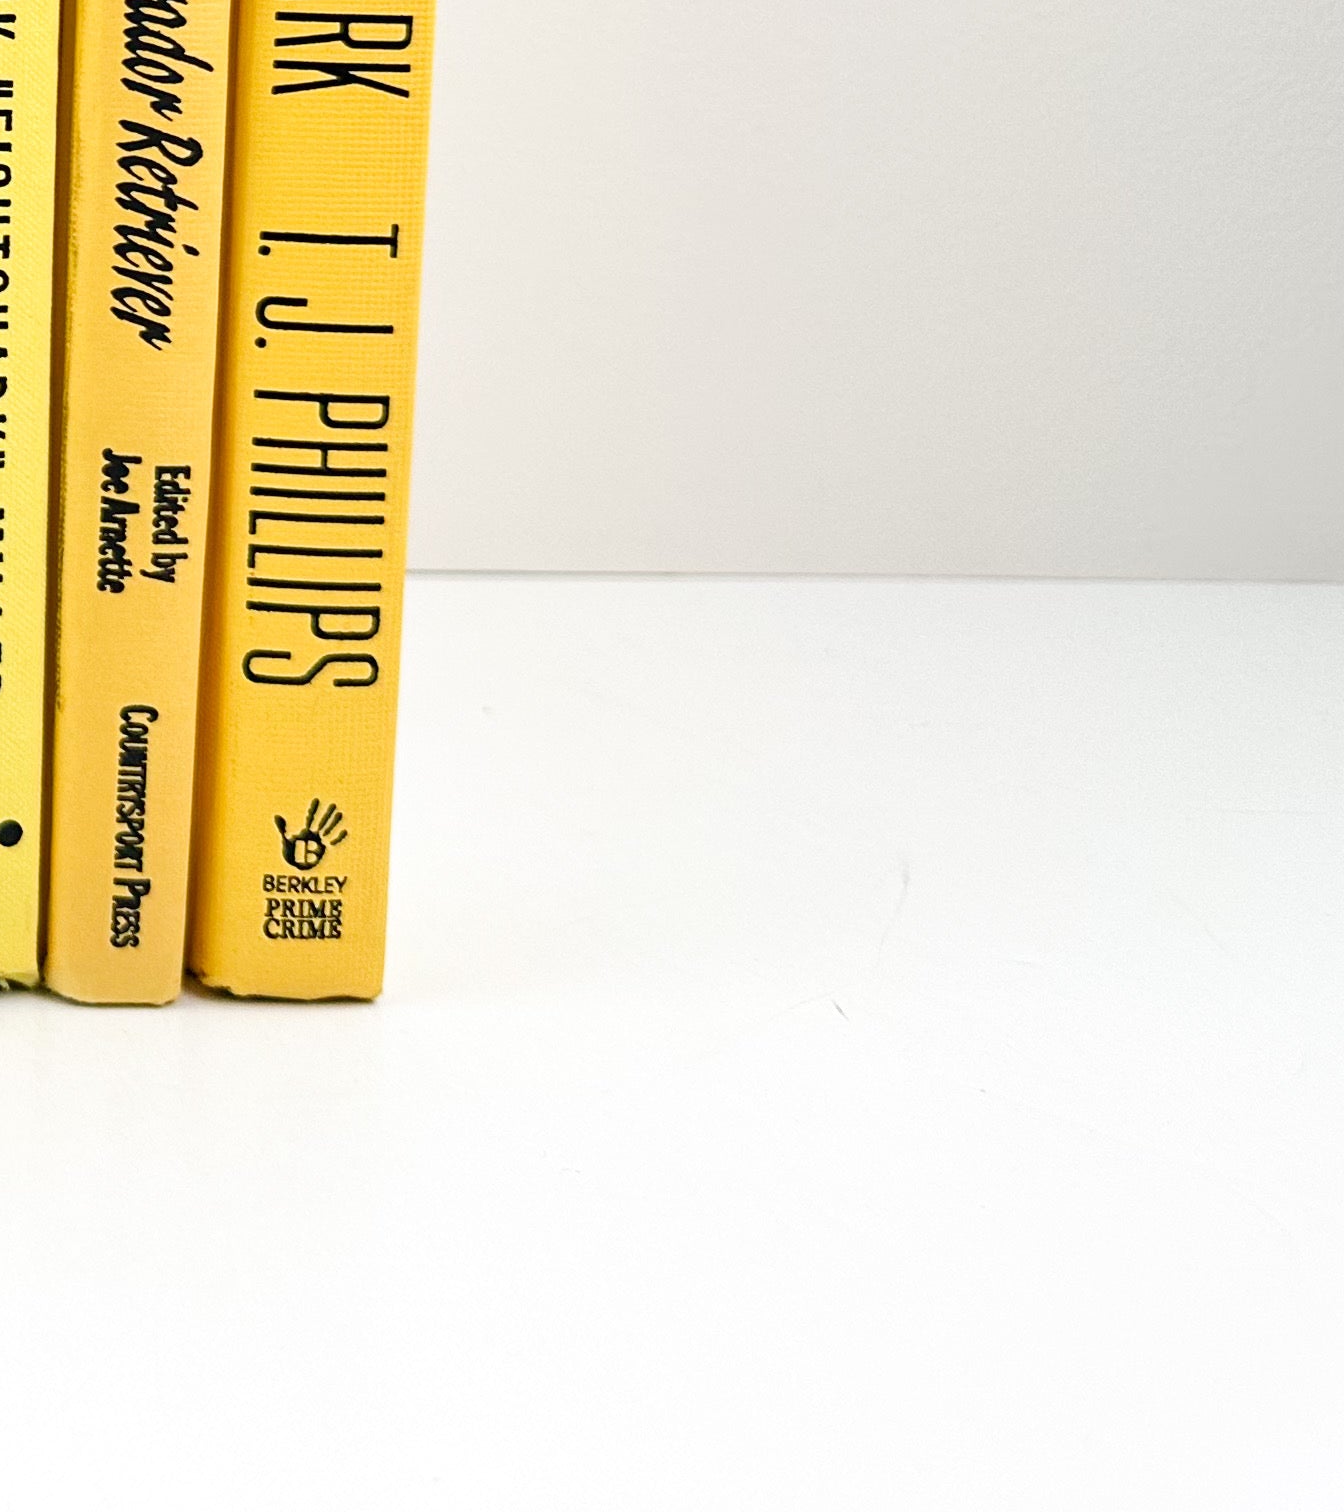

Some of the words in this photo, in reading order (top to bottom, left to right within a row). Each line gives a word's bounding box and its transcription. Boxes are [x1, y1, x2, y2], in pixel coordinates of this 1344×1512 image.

[110, 120, 204, 351] Retriever
[258, 223, 400, 259] T.
[254, 295, 394, 349] J.
[101, 447, 143, 494] Joe
[151, 465, 192, 545] Edited
[97, 495, 141, 594] Arnette
[242, 389, 391, 688] PHILLIPS
[139, 552, 189, 584] by
[262, 873, 348, 895] BERKLEY
[264, 898, 343, 920] PRIME
[109, 877, 152, 949] PRESS
[263, 918, 343, 940] CRIME
